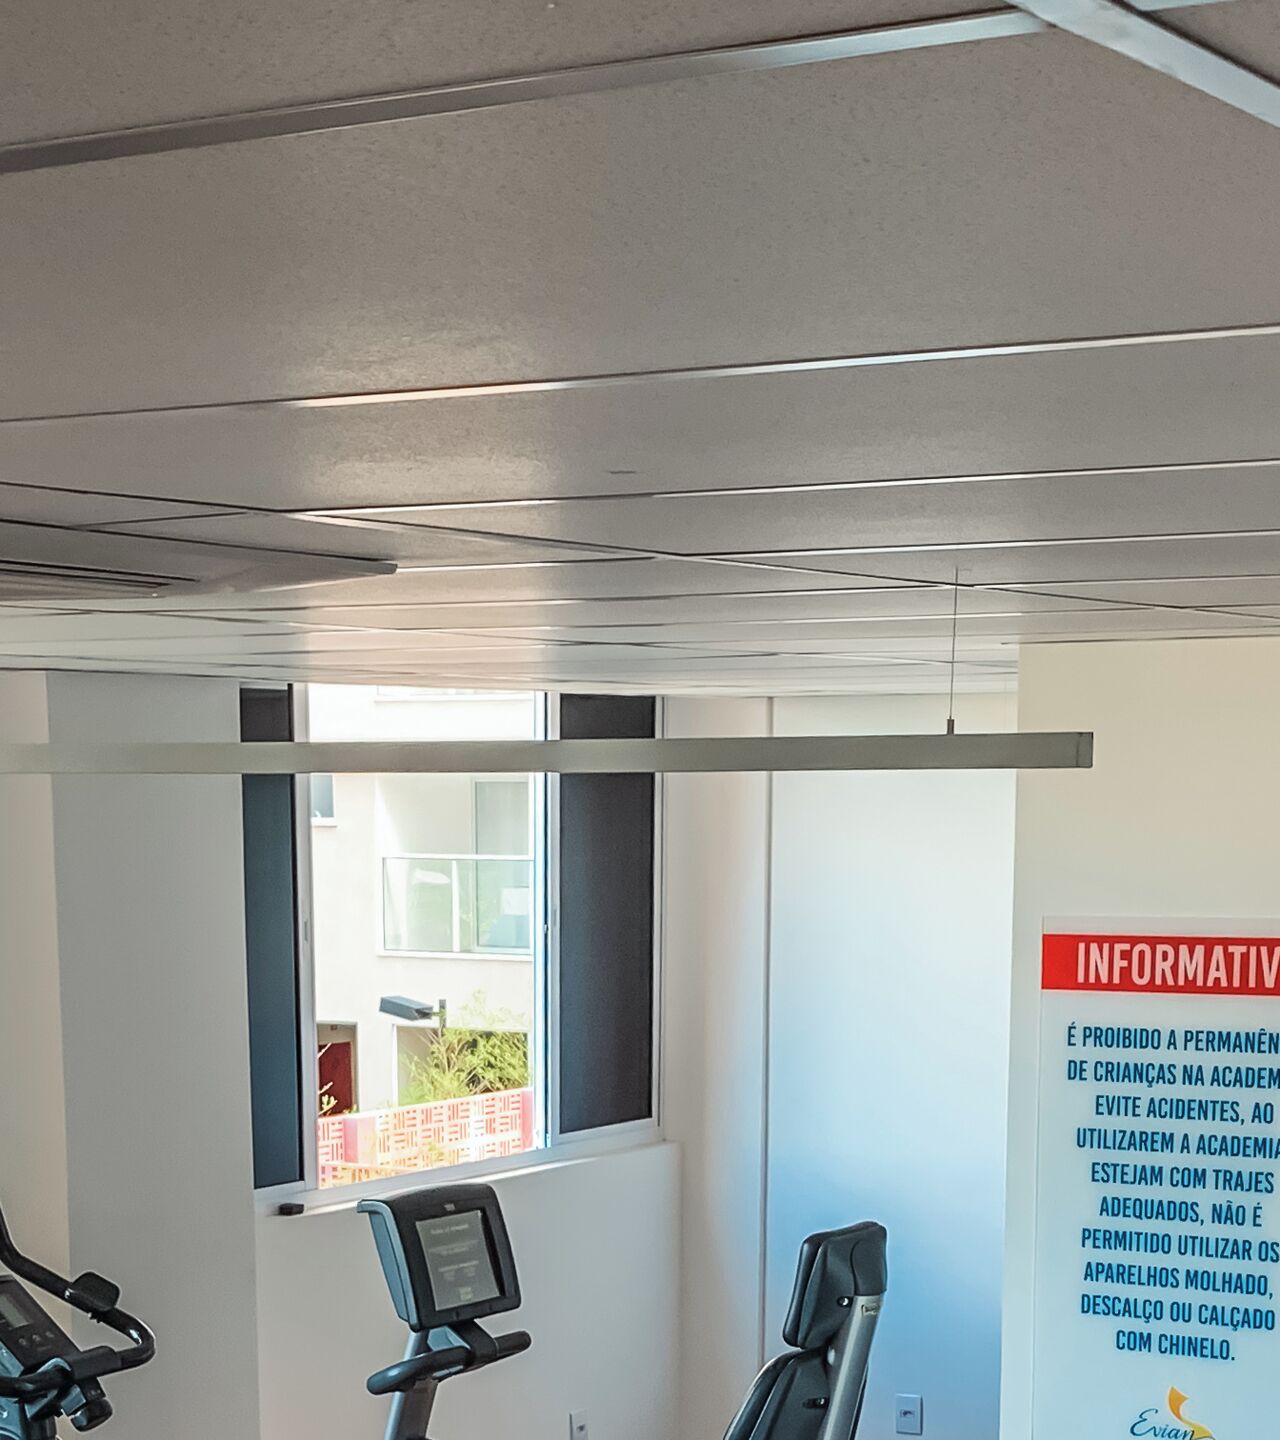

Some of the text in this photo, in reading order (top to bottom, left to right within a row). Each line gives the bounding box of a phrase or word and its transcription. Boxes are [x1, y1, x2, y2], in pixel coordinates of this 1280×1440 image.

[1067, 1021, 1077, 1047] É
[1082, 1026, 1162, 1051] PROIBIDO
[1166, 1029, 1178, 1051] A
[1067, 1059, 1089, 1082] DE
[1093, 1060, 1177, 1089] CRIANÇAS
[1181, 1064, 1205, 1087] NA
[1095, 1094, 1275, 1126] EVITE ACIDENTES, AO
[1076, 1127, 1175, 1154] UTILIZAREM
[1179, 1132, 1191, 1155] A
[1091, 1161, 1275, 1194] ESTEJAM COM TRAJES
[1099, 1195, 1263, 1228] ADEQUADOS, NÃO É
[1081, 1227, 1280, 1264] PERMITIDO UTILIZAR OS
[1083, 1261, 1273, 1300] APARELHOS MOLHADO,
[1080, 1293, 1276, 1332] DESCALÇO OU CALÇADO
[1115, 1329, 1235, 1361] COM CHINELO.
[1130, 1408, 1195, 1440] Evian
